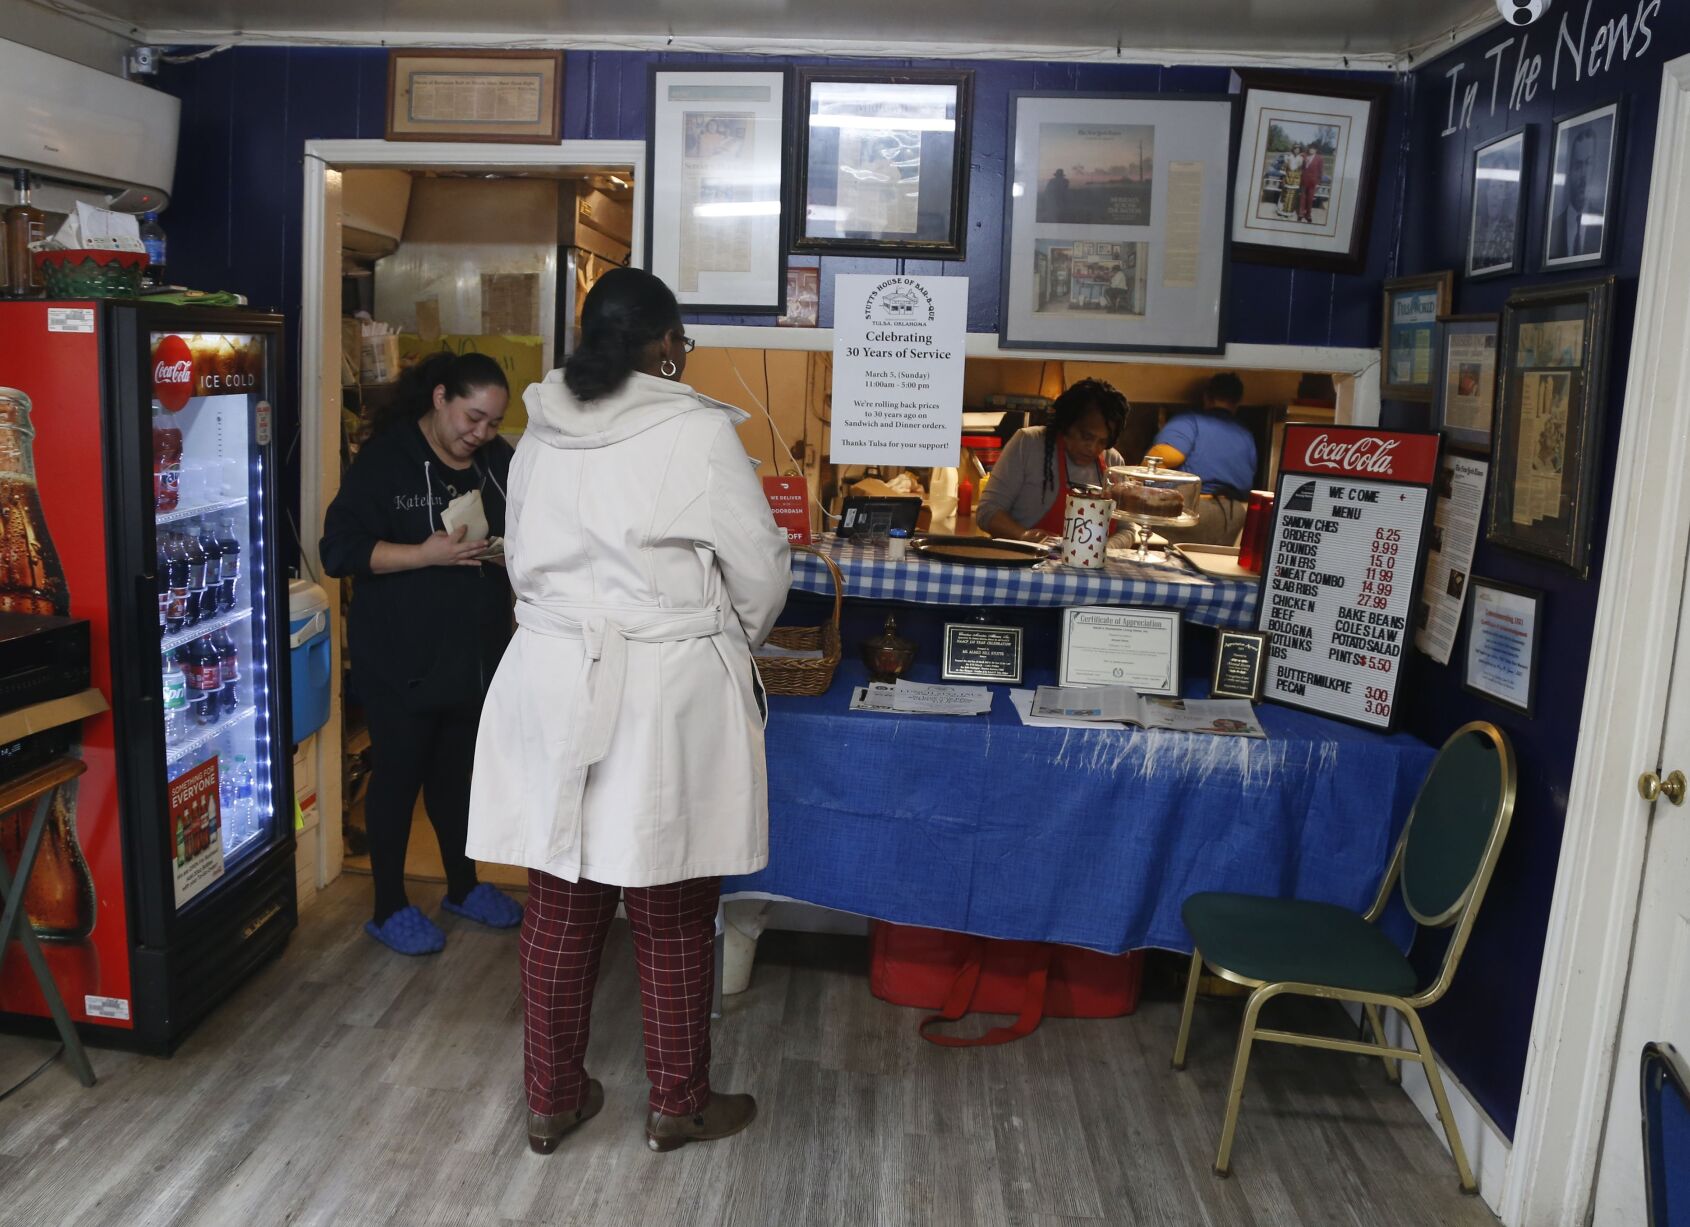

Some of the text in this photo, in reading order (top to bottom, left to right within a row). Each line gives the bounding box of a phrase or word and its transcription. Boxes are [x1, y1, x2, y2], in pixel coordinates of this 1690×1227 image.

[1441, 0, 1661, 137] In The News
[865, 291, 878, 319] STUTTS
[877, 278, 902, 291] HOUSE
[915, 283, 934, 321] BAR-B-QUE
[866, 331, 932, 345] Celebrating
[846, 347, 951, 359] 30 Years of Service
[155, 360, 192, 384] Coca-Cola
[898, 372, 929, 380] (Sunday)
[201, 374, 254, 388] ICE COLD
[875, 401, 898, 409] rolling
[918, 402, 939, 410] prices
[918, 442, 949, 450] support!
[1305, 434, 1400, 474] Coca-Cola
[1332, 506, 1362, 520] MENU
[1283, 530, 1321, 544] ORDERS
[1280, 541, 1318, 556] POUNDS
[1371, 541, 1398, 555] 9.99
[1309, 571, 1345, 588] COMBO
[1362, 581, 1392, 596] 14.99
[1273, 594, 1315, 612] CHICKEN
[1357, 594, 1387, 609] 27.99
[1271, 607, 1295, 619] BEEF
[1338, 606, 1404, 630] BAKE BEANS
[1080, 615, 1112, 625] Certificate
[1123, 618, 1162, 627] Appreciation
[1268, 619, 1312, 639] BOLOGNA
[1272, 633, 1312, 652] OTLINKS
[1269, 646, 1287, 659] IBS
[1276, 678, 1306, 696] PECAN
[1365, 700, 1390, 717] 3.00
[172, 766, 214, 796] SOMETHING FOR
[172, 773, 215, 808] EVERYONE
